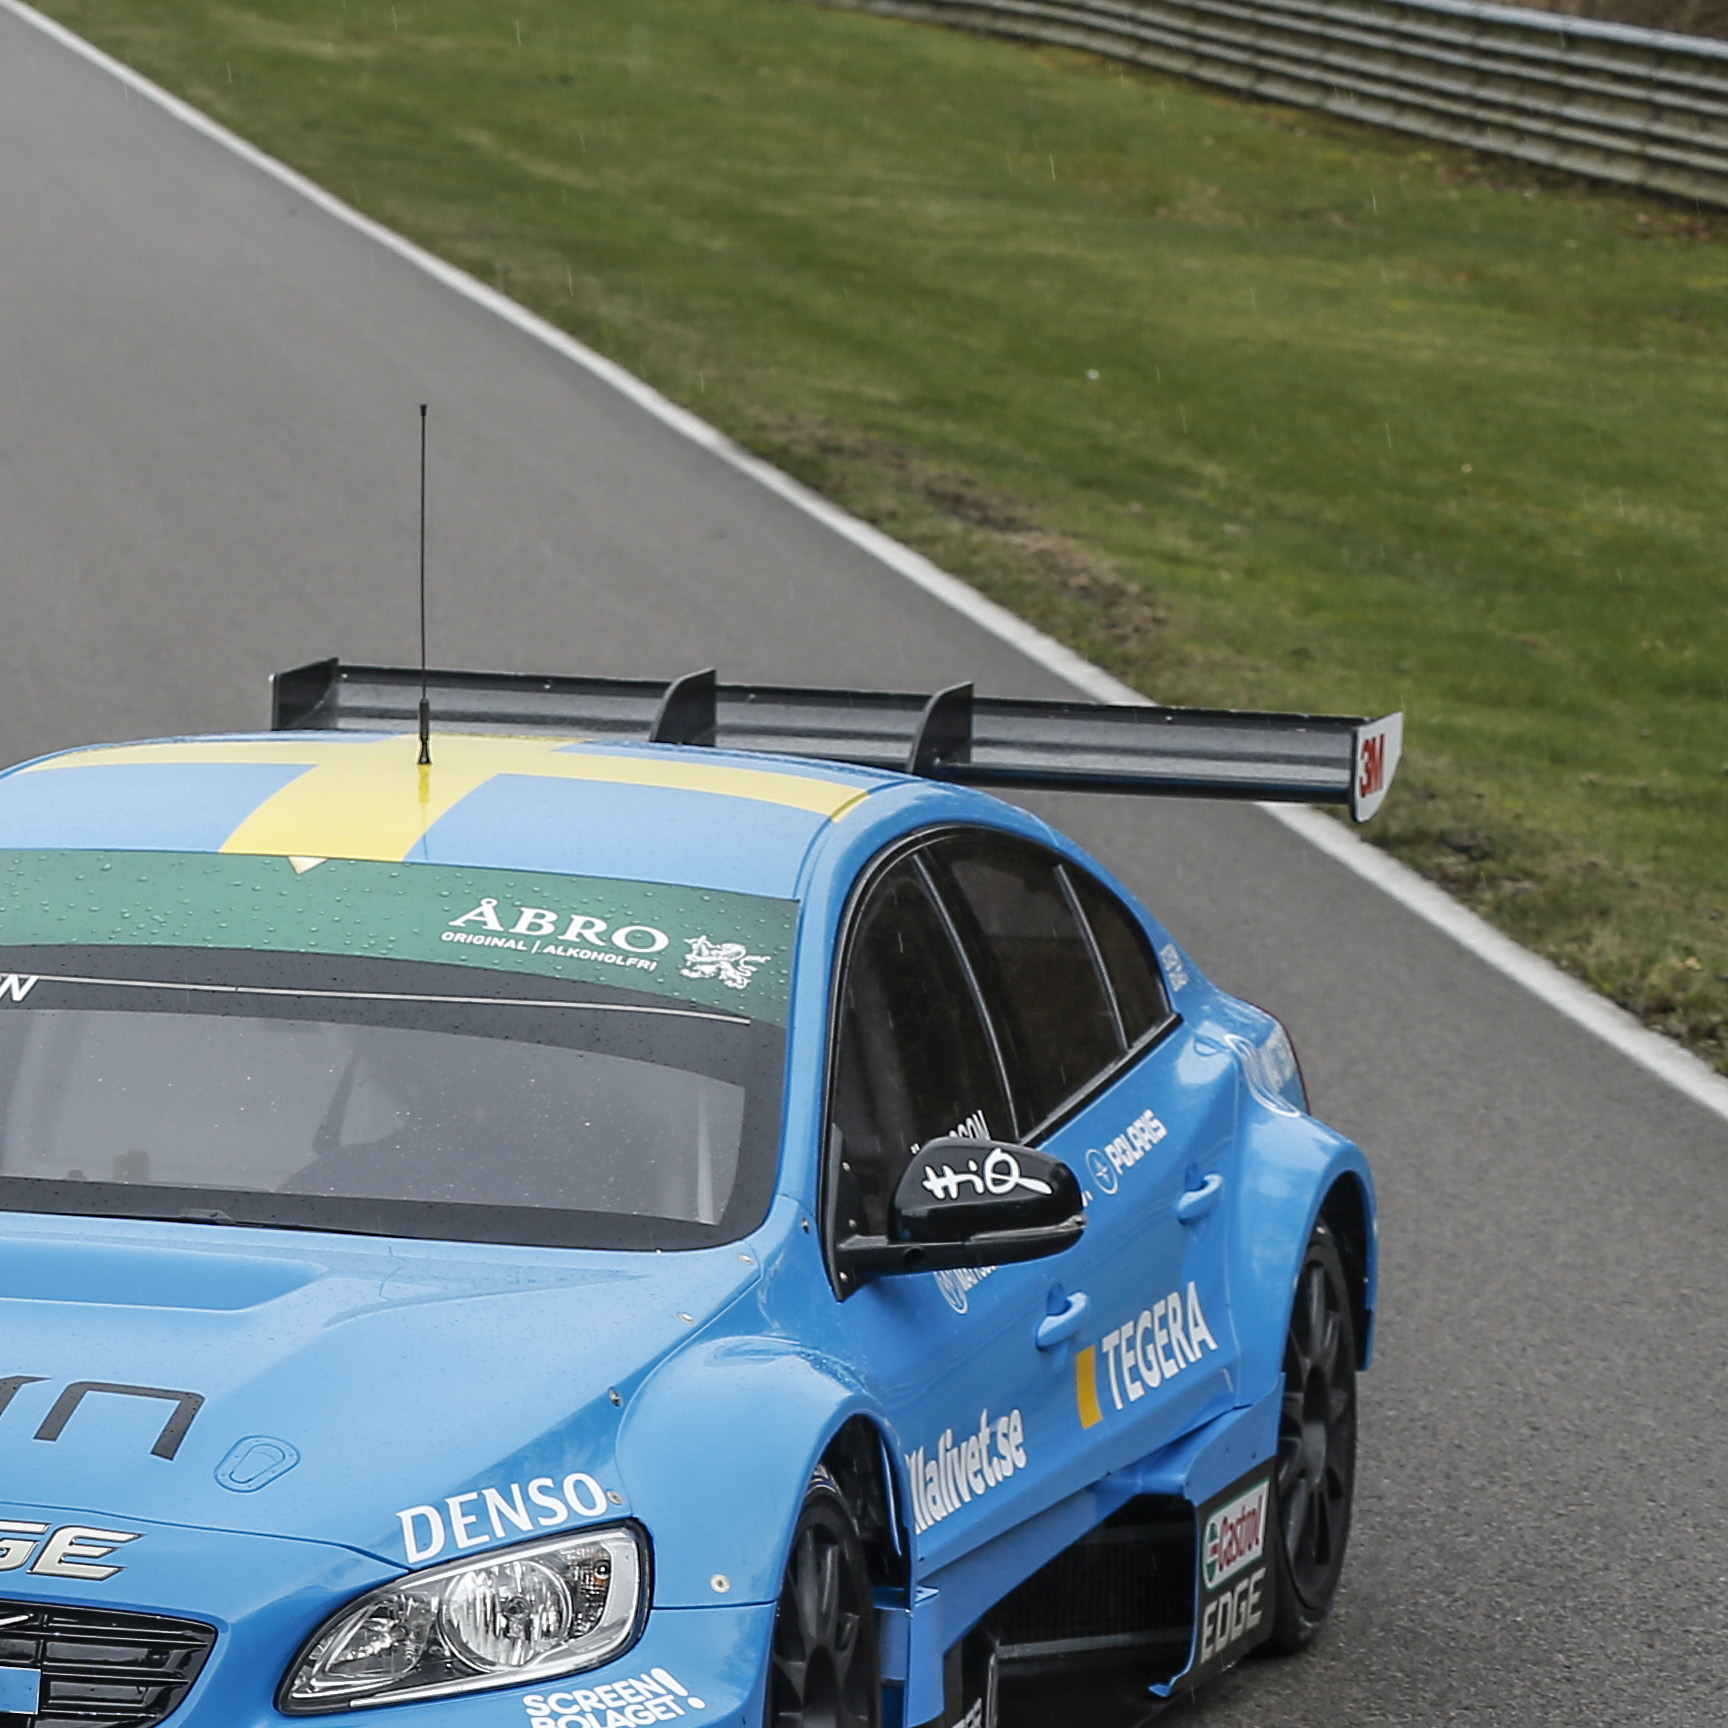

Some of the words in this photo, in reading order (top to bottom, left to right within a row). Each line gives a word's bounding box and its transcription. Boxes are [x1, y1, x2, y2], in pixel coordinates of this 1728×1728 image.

[1359, 733, 1385, 798] 3M
[440, 931, 528, 951] ORIGINAL
[542, 945, 658, 972] ALKOHOLFRI
[448, 897, 670, 953] ÅBRO
[922, 1147, 1054, 1200] HiQ
[1104, 1108, 1169, 1175] POLARIS
[1101, 1280, 1219, 1411] TEGERA
[395, 1472, 609, 1564] DENSO
[1200, 1567, 1267, 1664] EDGE
[523, 1672, 666, 1718] SCREEN
